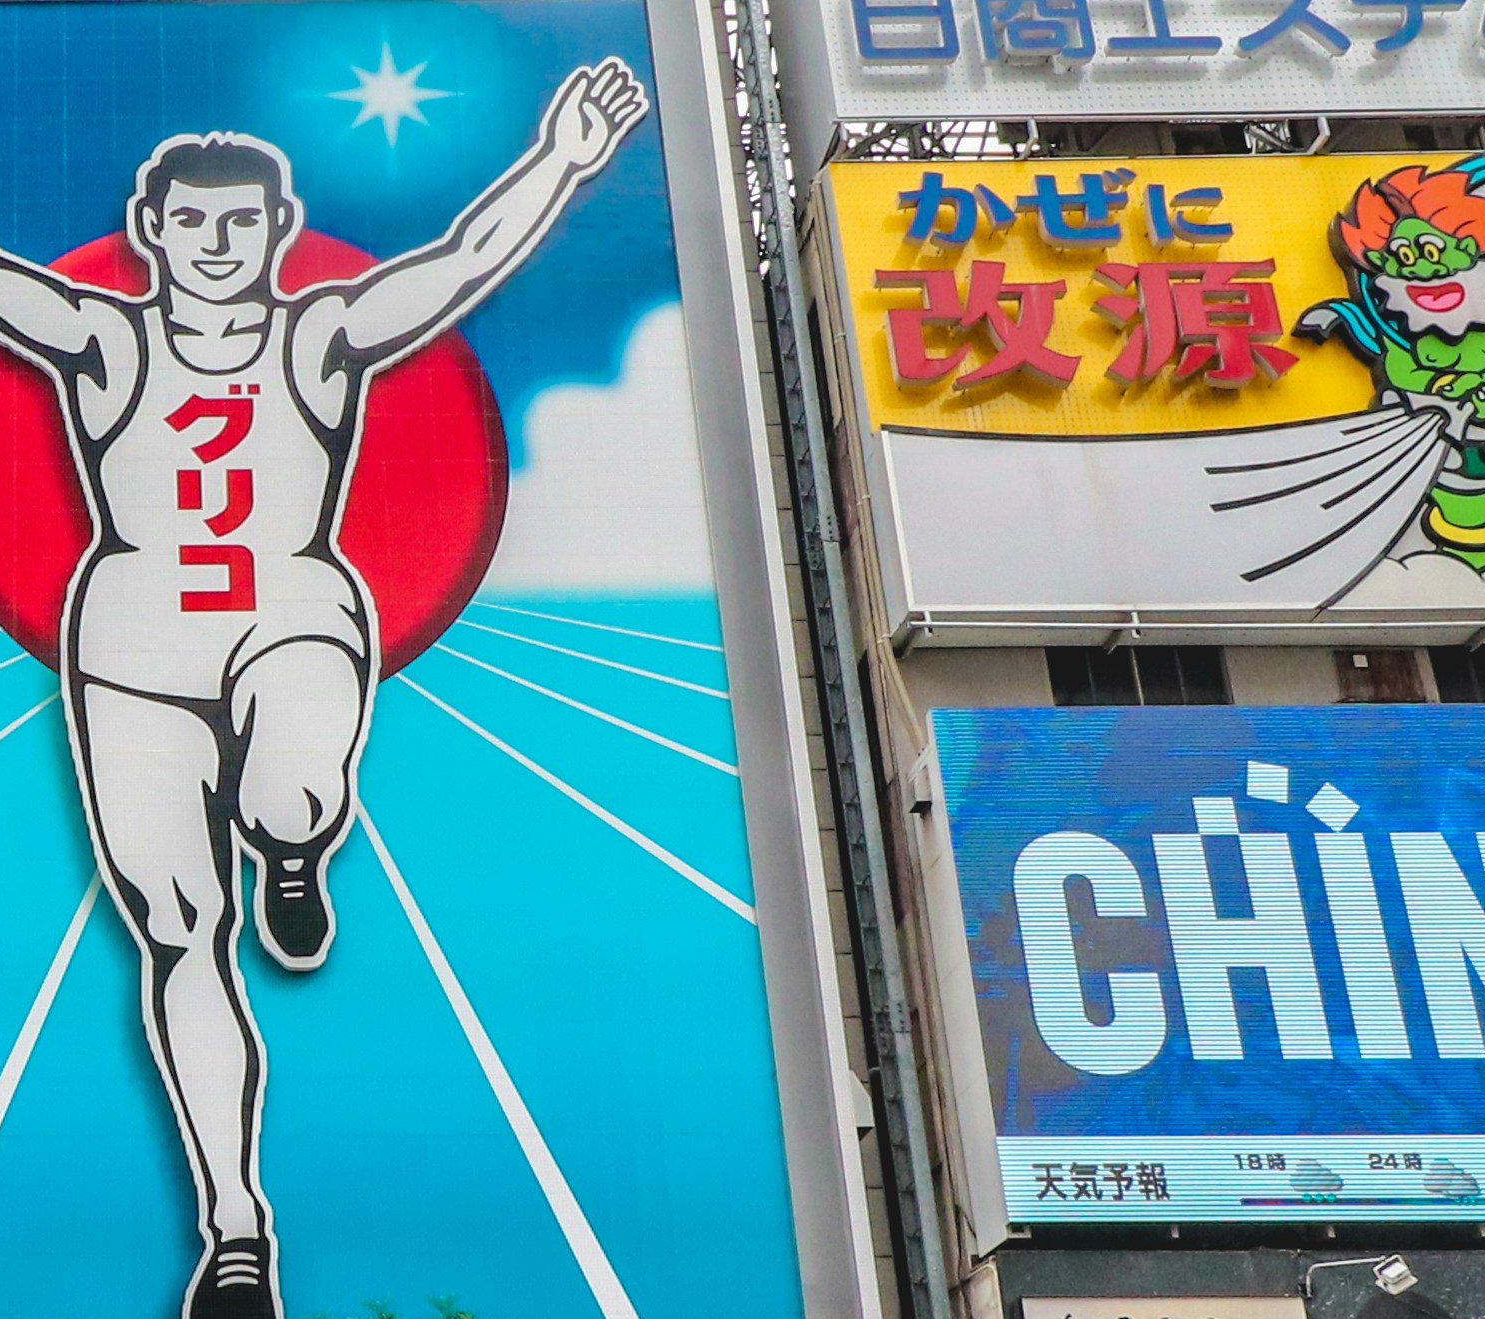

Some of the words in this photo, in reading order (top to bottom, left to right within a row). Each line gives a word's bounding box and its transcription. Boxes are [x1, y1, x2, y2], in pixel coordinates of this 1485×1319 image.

[896, 167, 1236, 250] かぜに
[873, 257, 1301, 393] 改源
[162, 383, 262, 613] グリコ
[1034, 1160, 1172, 1204] 天気予報
[1232, 1151, 1287, 1173] 18時
[1366, 1151, 1425, 1173] 24時
